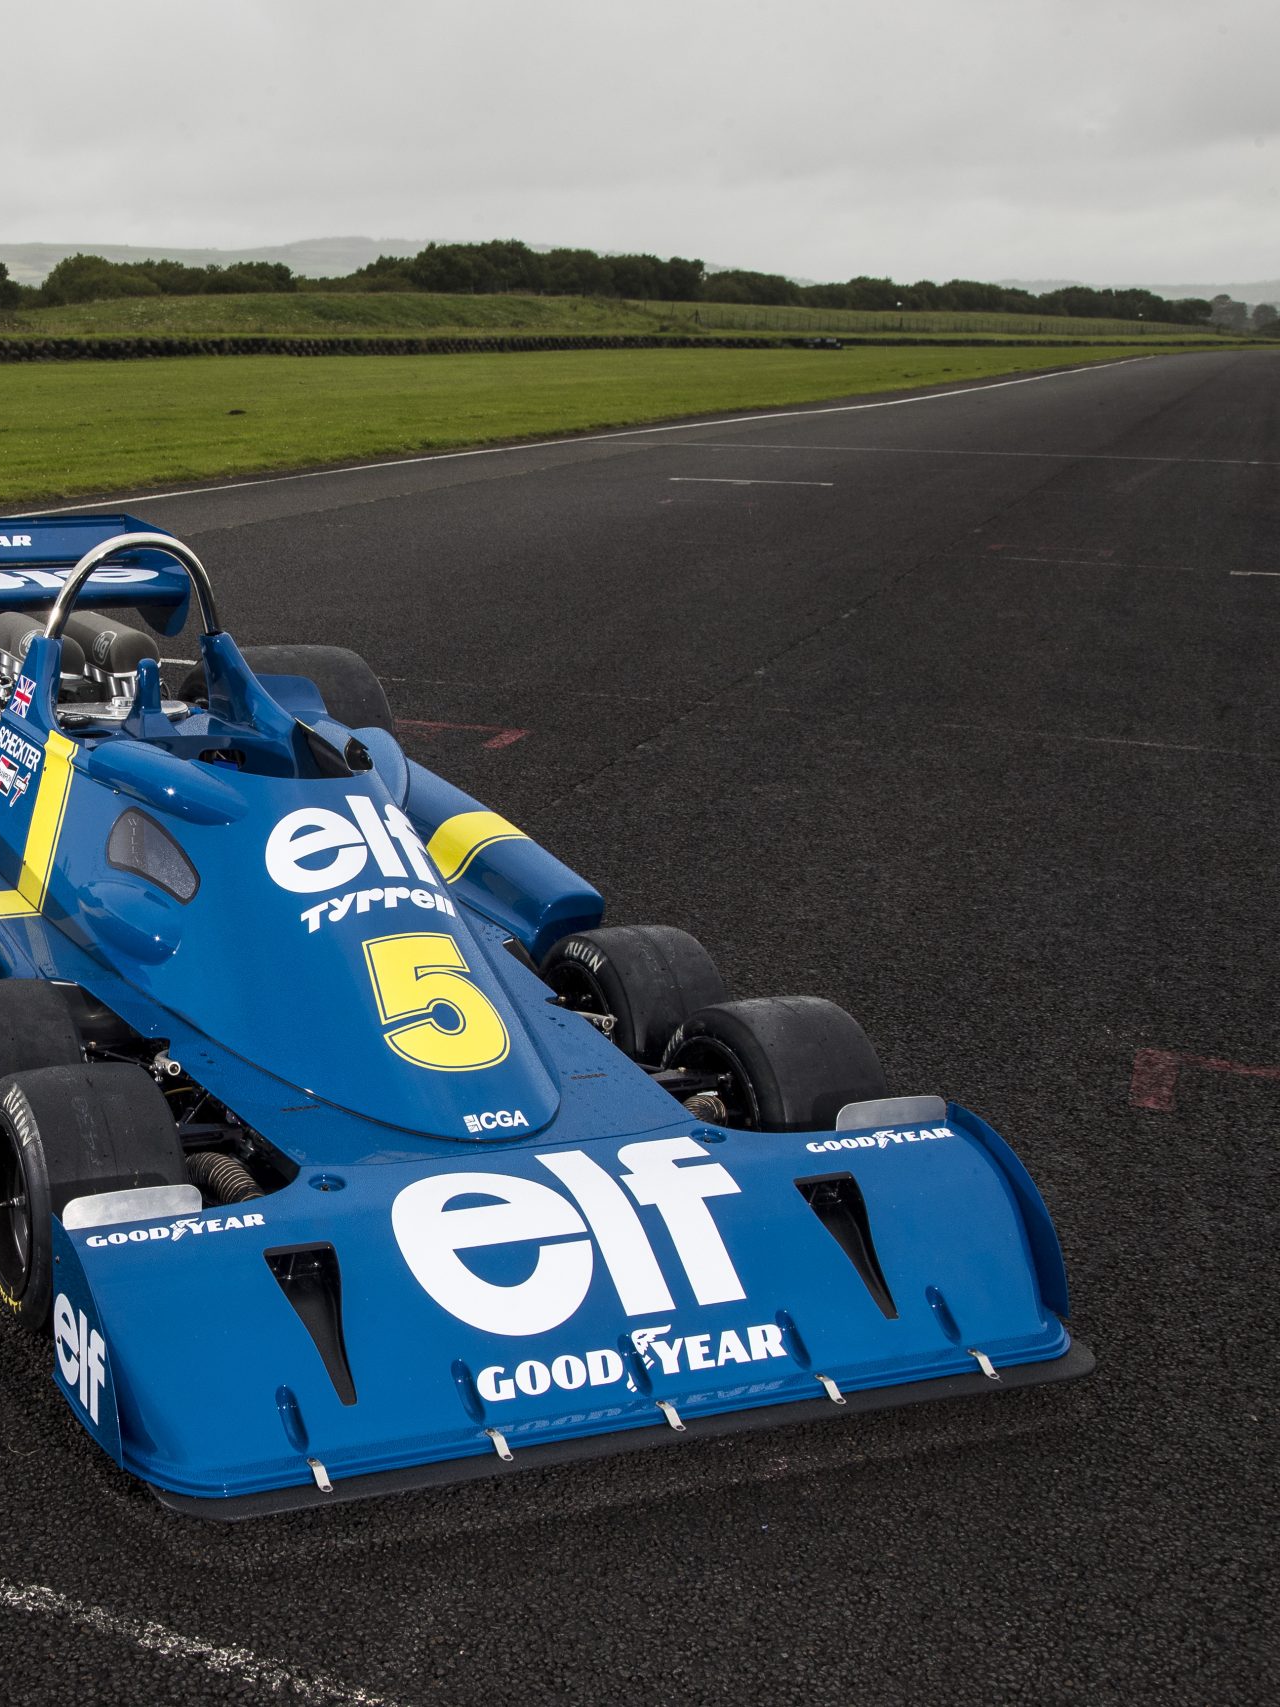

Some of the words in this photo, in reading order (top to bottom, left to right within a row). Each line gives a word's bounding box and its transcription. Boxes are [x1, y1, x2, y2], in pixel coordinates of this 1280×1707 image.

[265, 795, 439, 894] elf
[300, 886, 456, 934] Tyrrell
[362, 932, 511, 1073] 5
[480, 1110, 530, 1130] CGA
[391, 1136, 747, 1337] elf
[54, 1293, 107, 1426] elf
